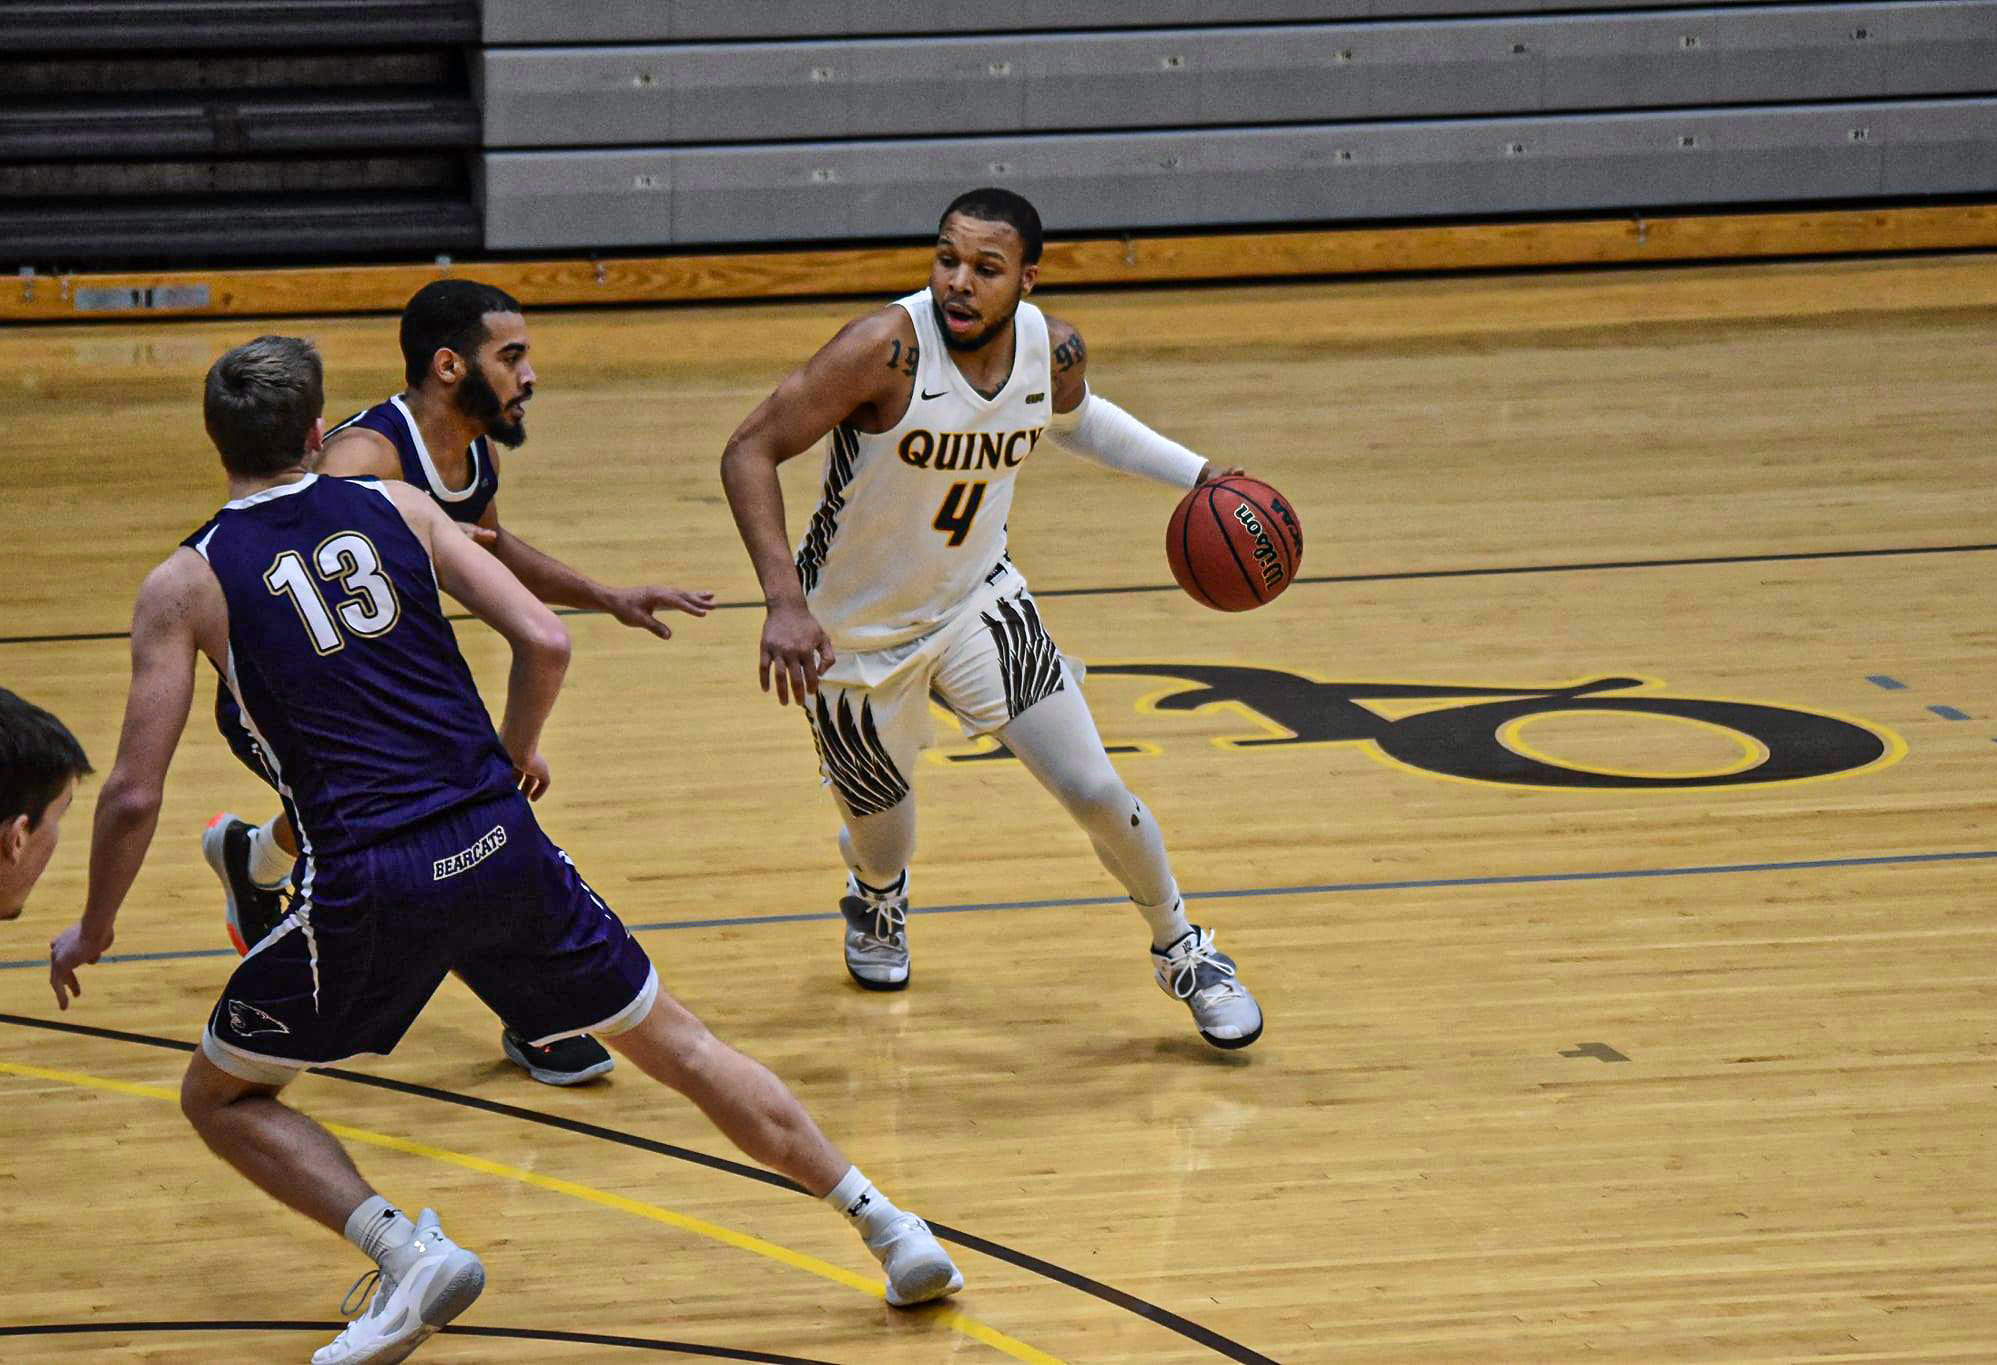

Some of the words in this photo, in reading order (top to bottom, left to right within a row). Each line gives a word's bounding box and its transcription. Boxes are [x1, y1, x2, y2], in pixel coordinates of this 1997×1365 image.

[931, 479, 989, 548] 4
[1233, 503, 1284, 593] Wilson
[263, 531, 400, 656] 13
[433, 825, 507, 880] BEARCATS
